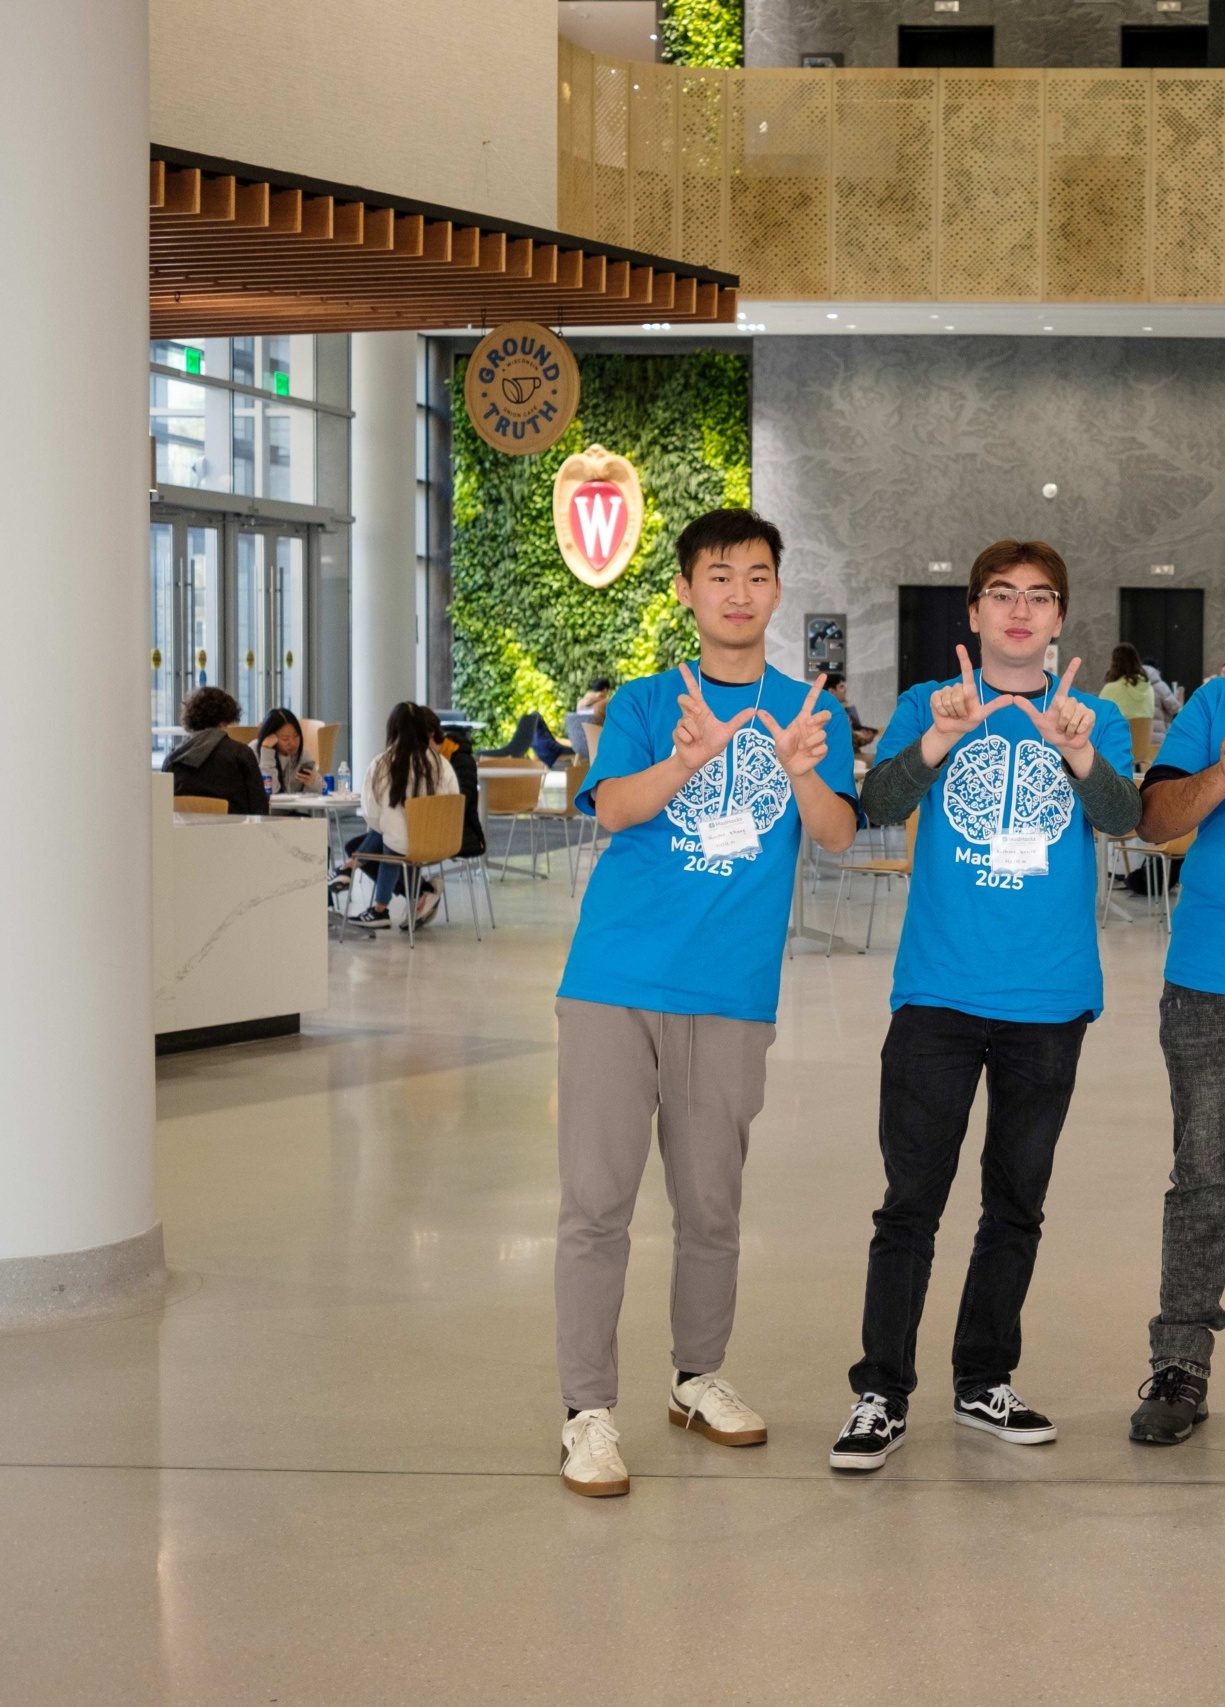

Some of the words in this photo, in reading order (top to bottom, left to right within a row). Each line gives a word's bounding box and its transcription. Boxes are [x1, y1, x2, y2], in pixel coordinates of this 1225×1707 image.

[478, 336, 560, 384] GROUND
[506, 359, 538, 371] WISCONSIN
[483, 400, 558, 440] TRUTH
[503, 407, 521, 418] UNION
[574, 493, 623, 558] W
[683, 855, 734, 877] 2025
[975, 869, 1024, 890] 2025
